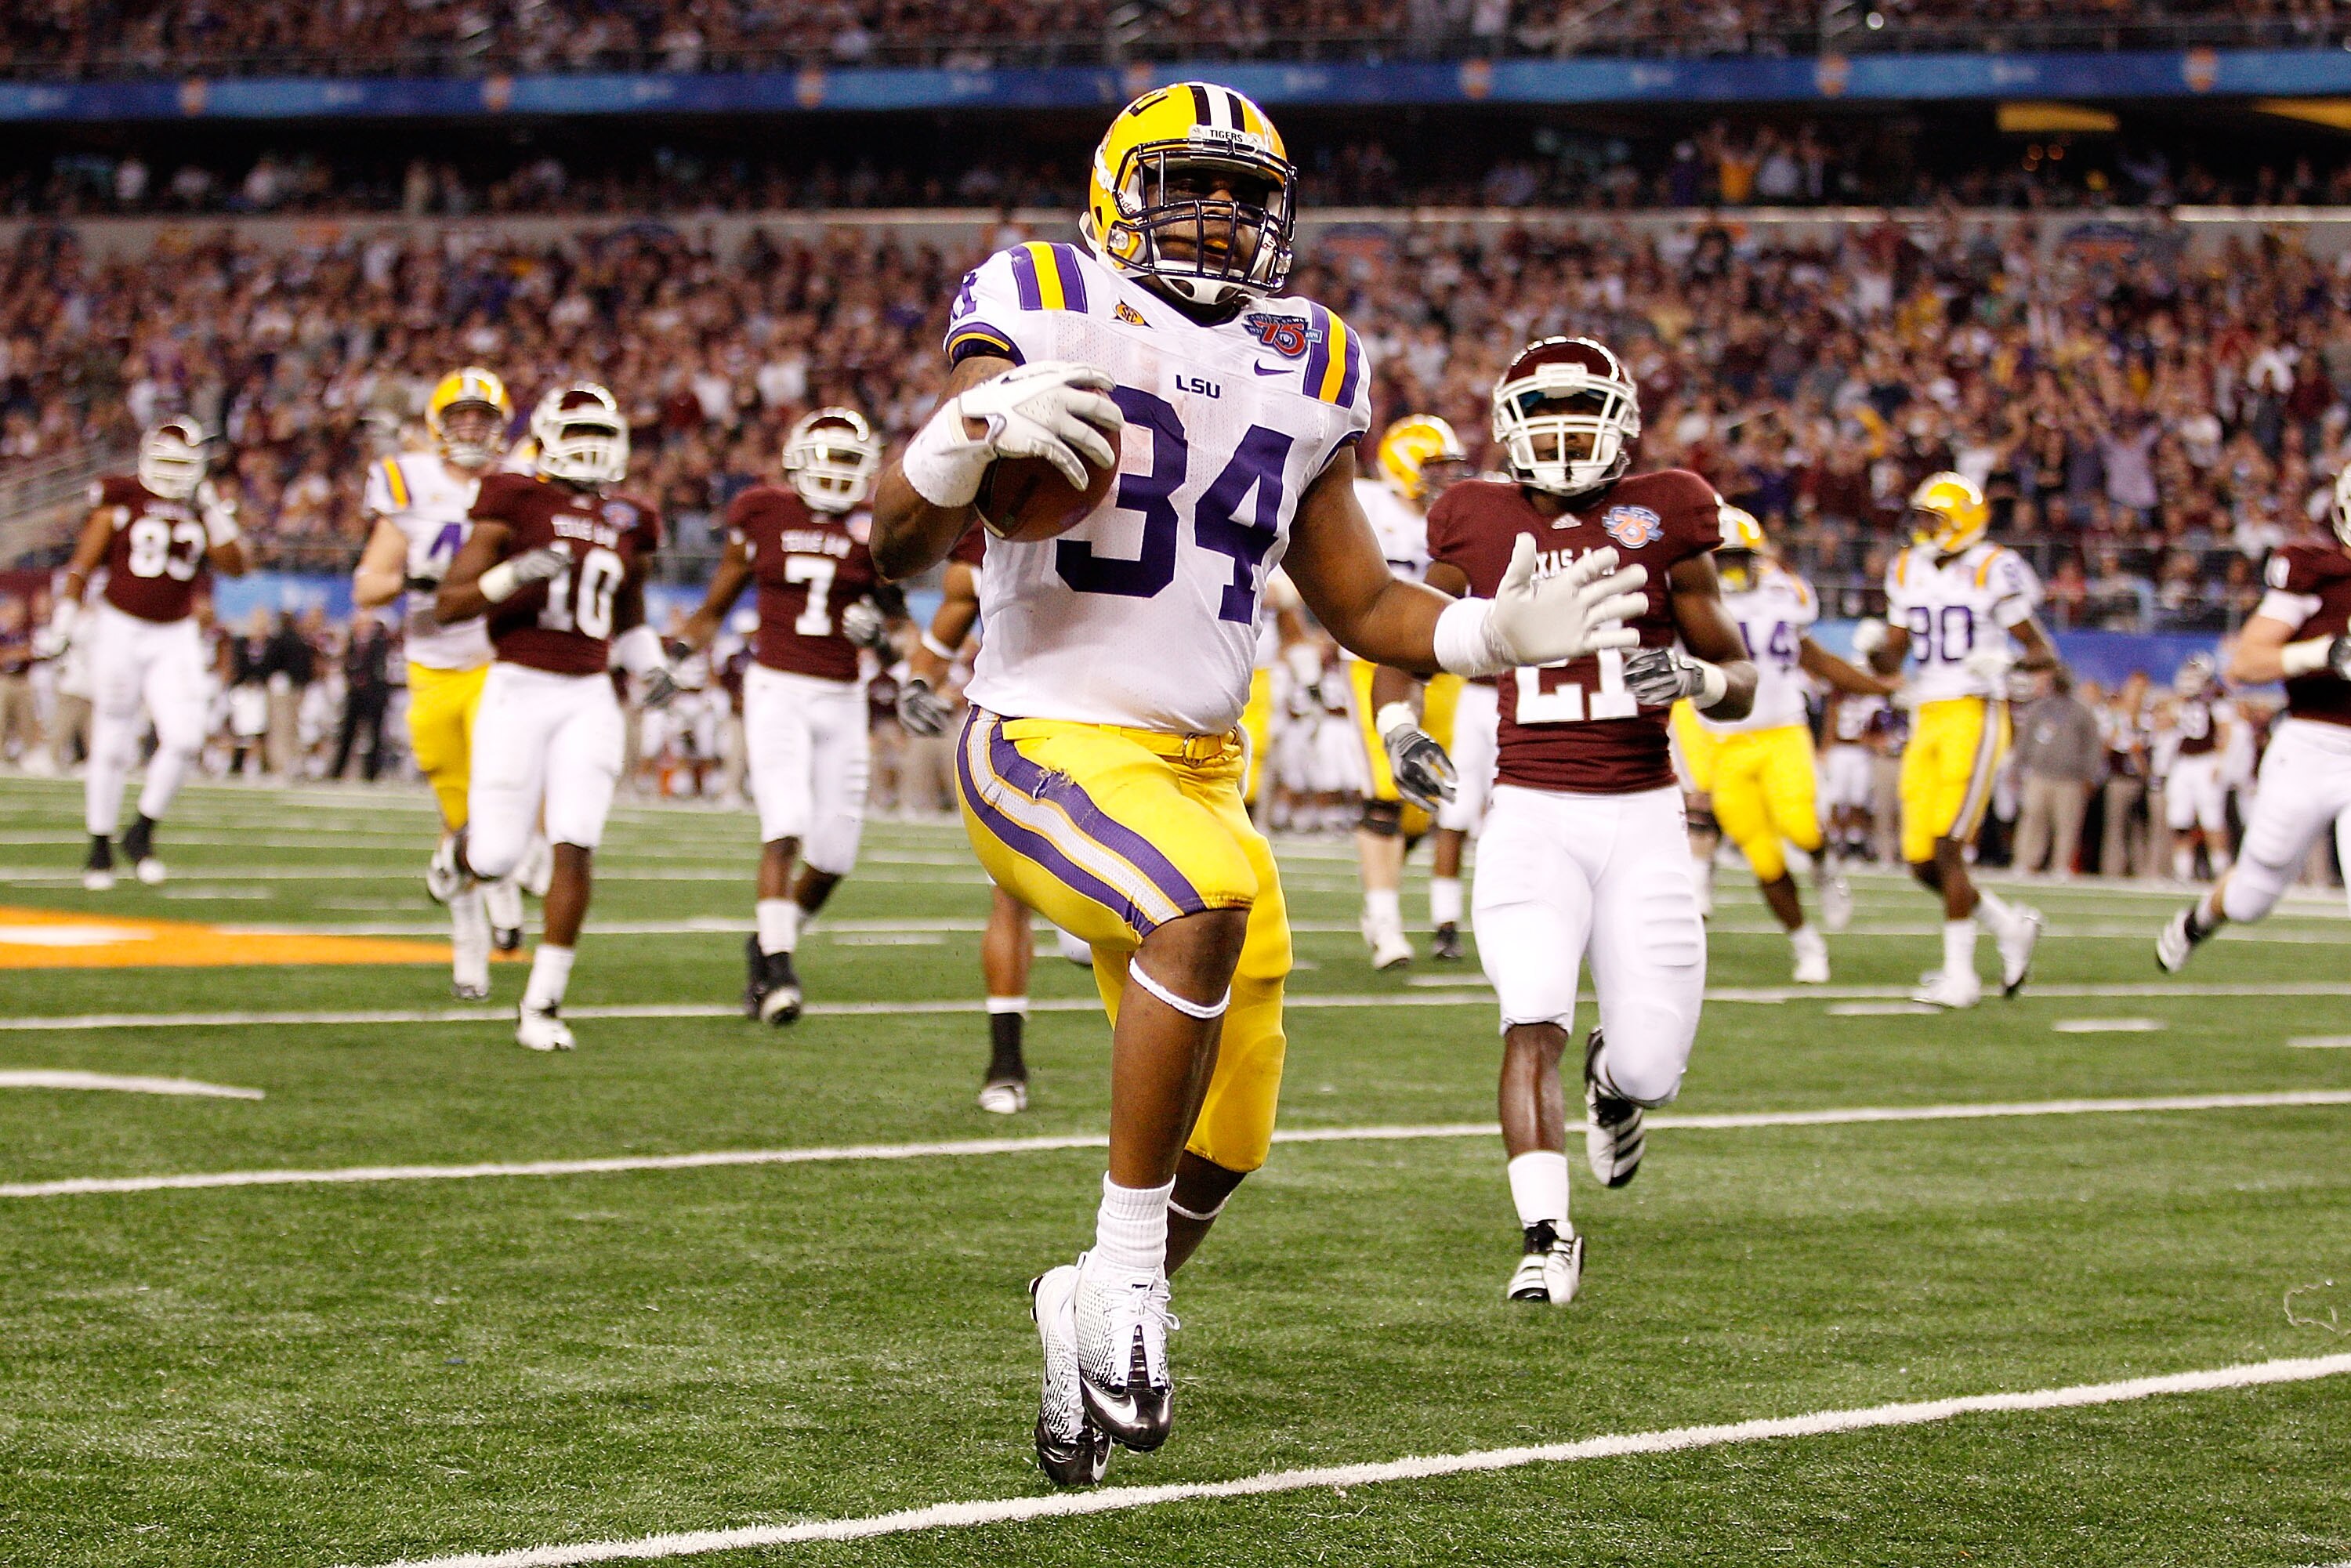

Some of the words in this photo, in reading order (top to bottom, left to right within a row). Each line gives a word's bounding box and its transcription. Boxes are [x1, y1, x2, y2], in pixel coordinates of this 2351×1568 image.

[1209, 129, 1243, 143] TIGERS
[1121, 306, 1138, 323] SEC
[1254, 320, 1306, 356] 75
[1176, 374, 1220, 399] LSU
[1055, 385, 1295, 626] 34
[1614, 513, 1655, 545] 75
[537, 539, 625, 641] 10
[784, 554, 837, 636] 7
